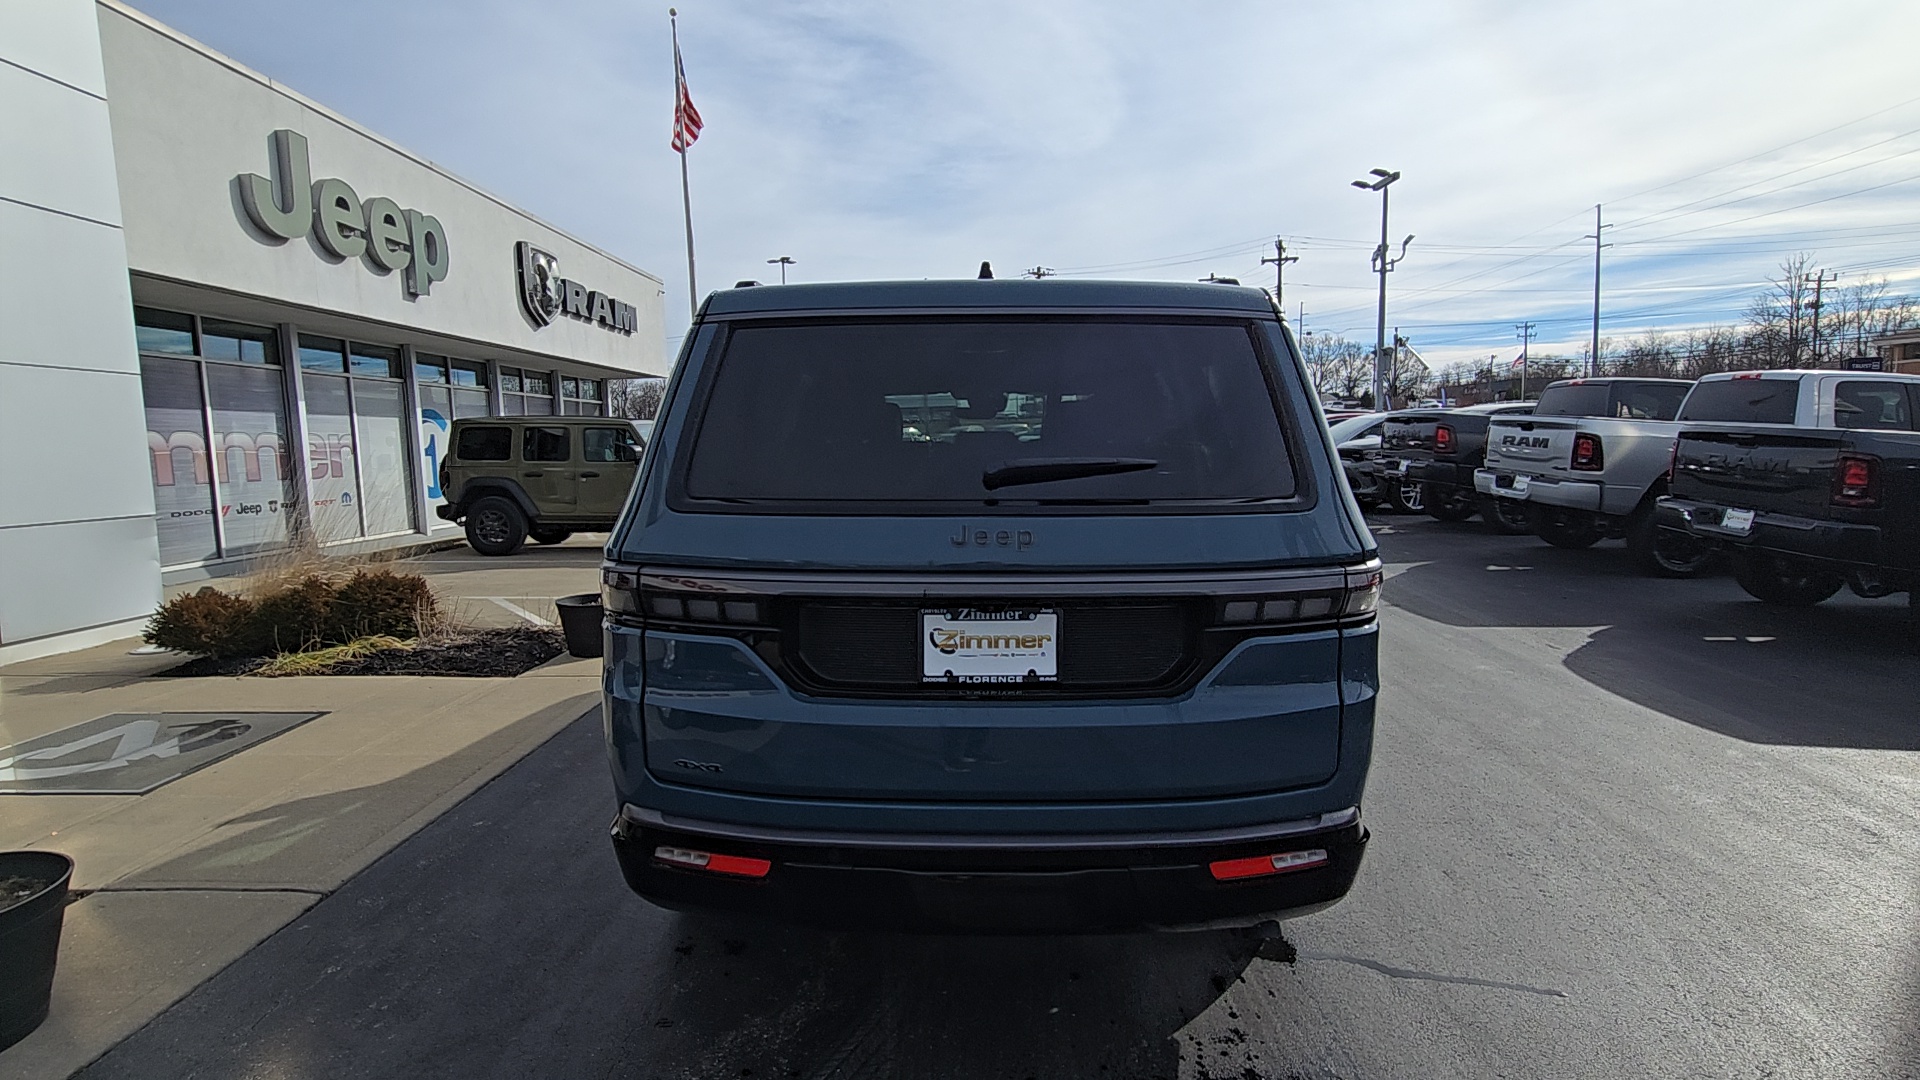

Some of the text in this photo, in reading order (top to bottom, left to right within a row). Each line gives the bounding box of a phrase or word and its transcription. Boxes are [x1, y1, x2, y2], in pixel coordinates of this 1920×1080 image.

[230, 129, 449, 300] Jeep
[560, 279, 638, 334] RAM
[1501, 435, 1550, 449] RAM
[170, 508, 216, 518] DODG
[235, 502, 262, 516] Jeep
[949, 524, 1034, 552] Jeep
[958, 608, 1022, 620] Zimmer
[936, 629, 1052, 650] Zimmer
[958, 675, 1024, 684] FLORENCE
